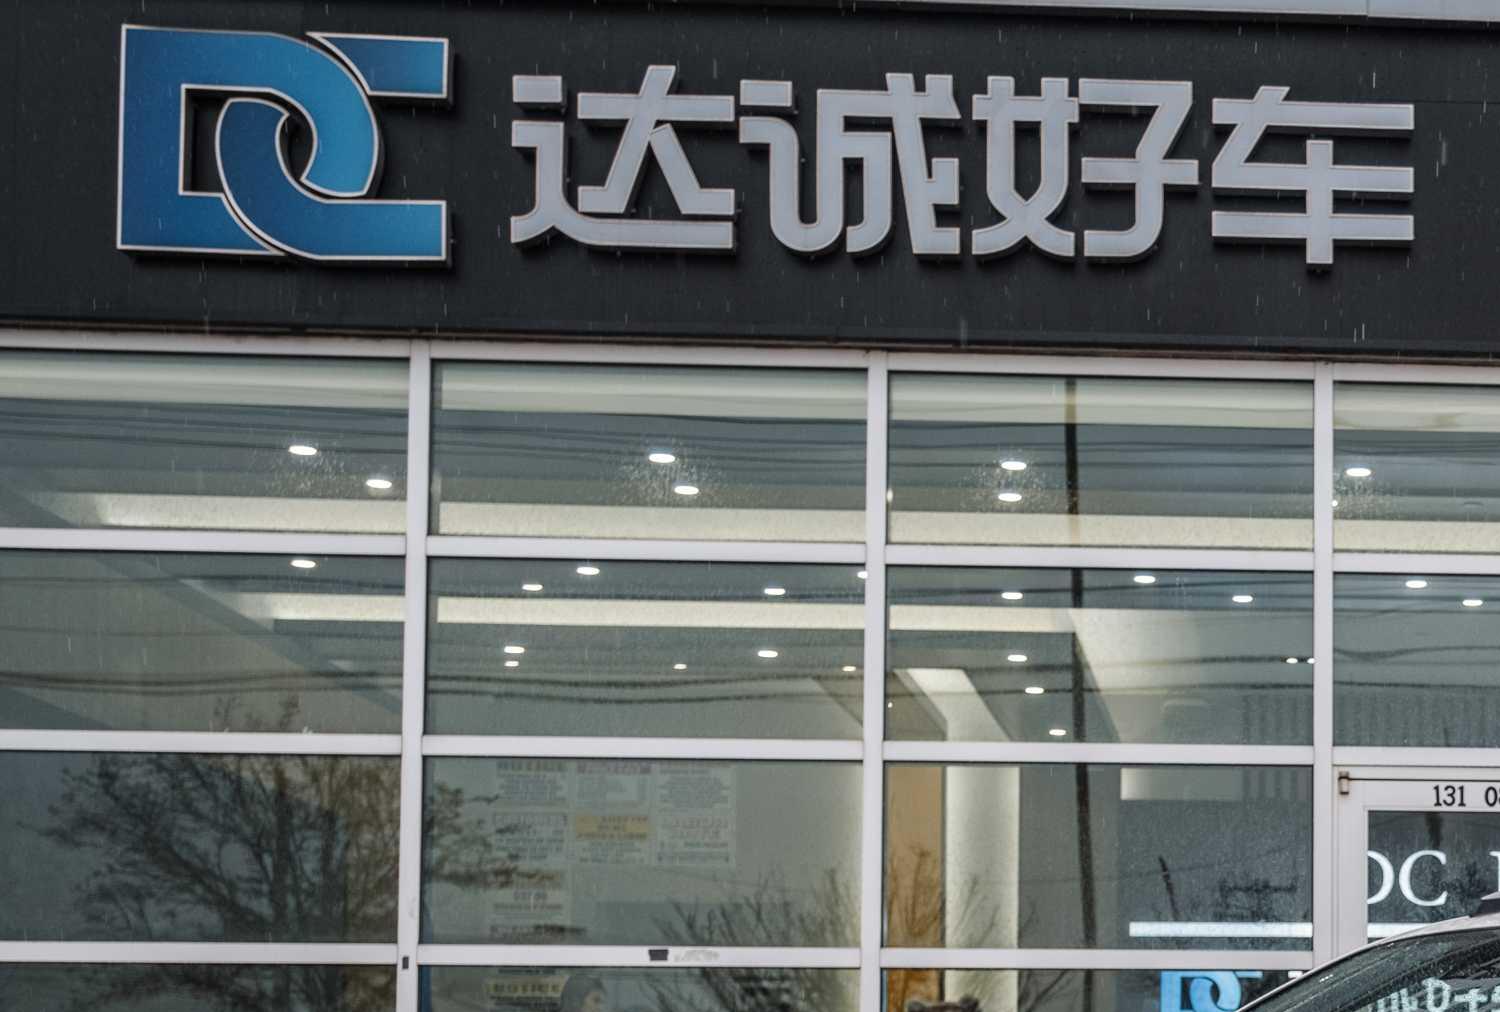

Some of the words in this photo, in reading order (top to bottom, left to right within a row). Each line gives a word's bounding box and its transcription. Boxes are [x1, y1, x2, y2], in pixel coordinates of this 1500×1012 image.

[117, 24, 449, 261] DC
[510, 65, 1415, 266] 达诚好车
[1432, 785, 1467, 808] 131
